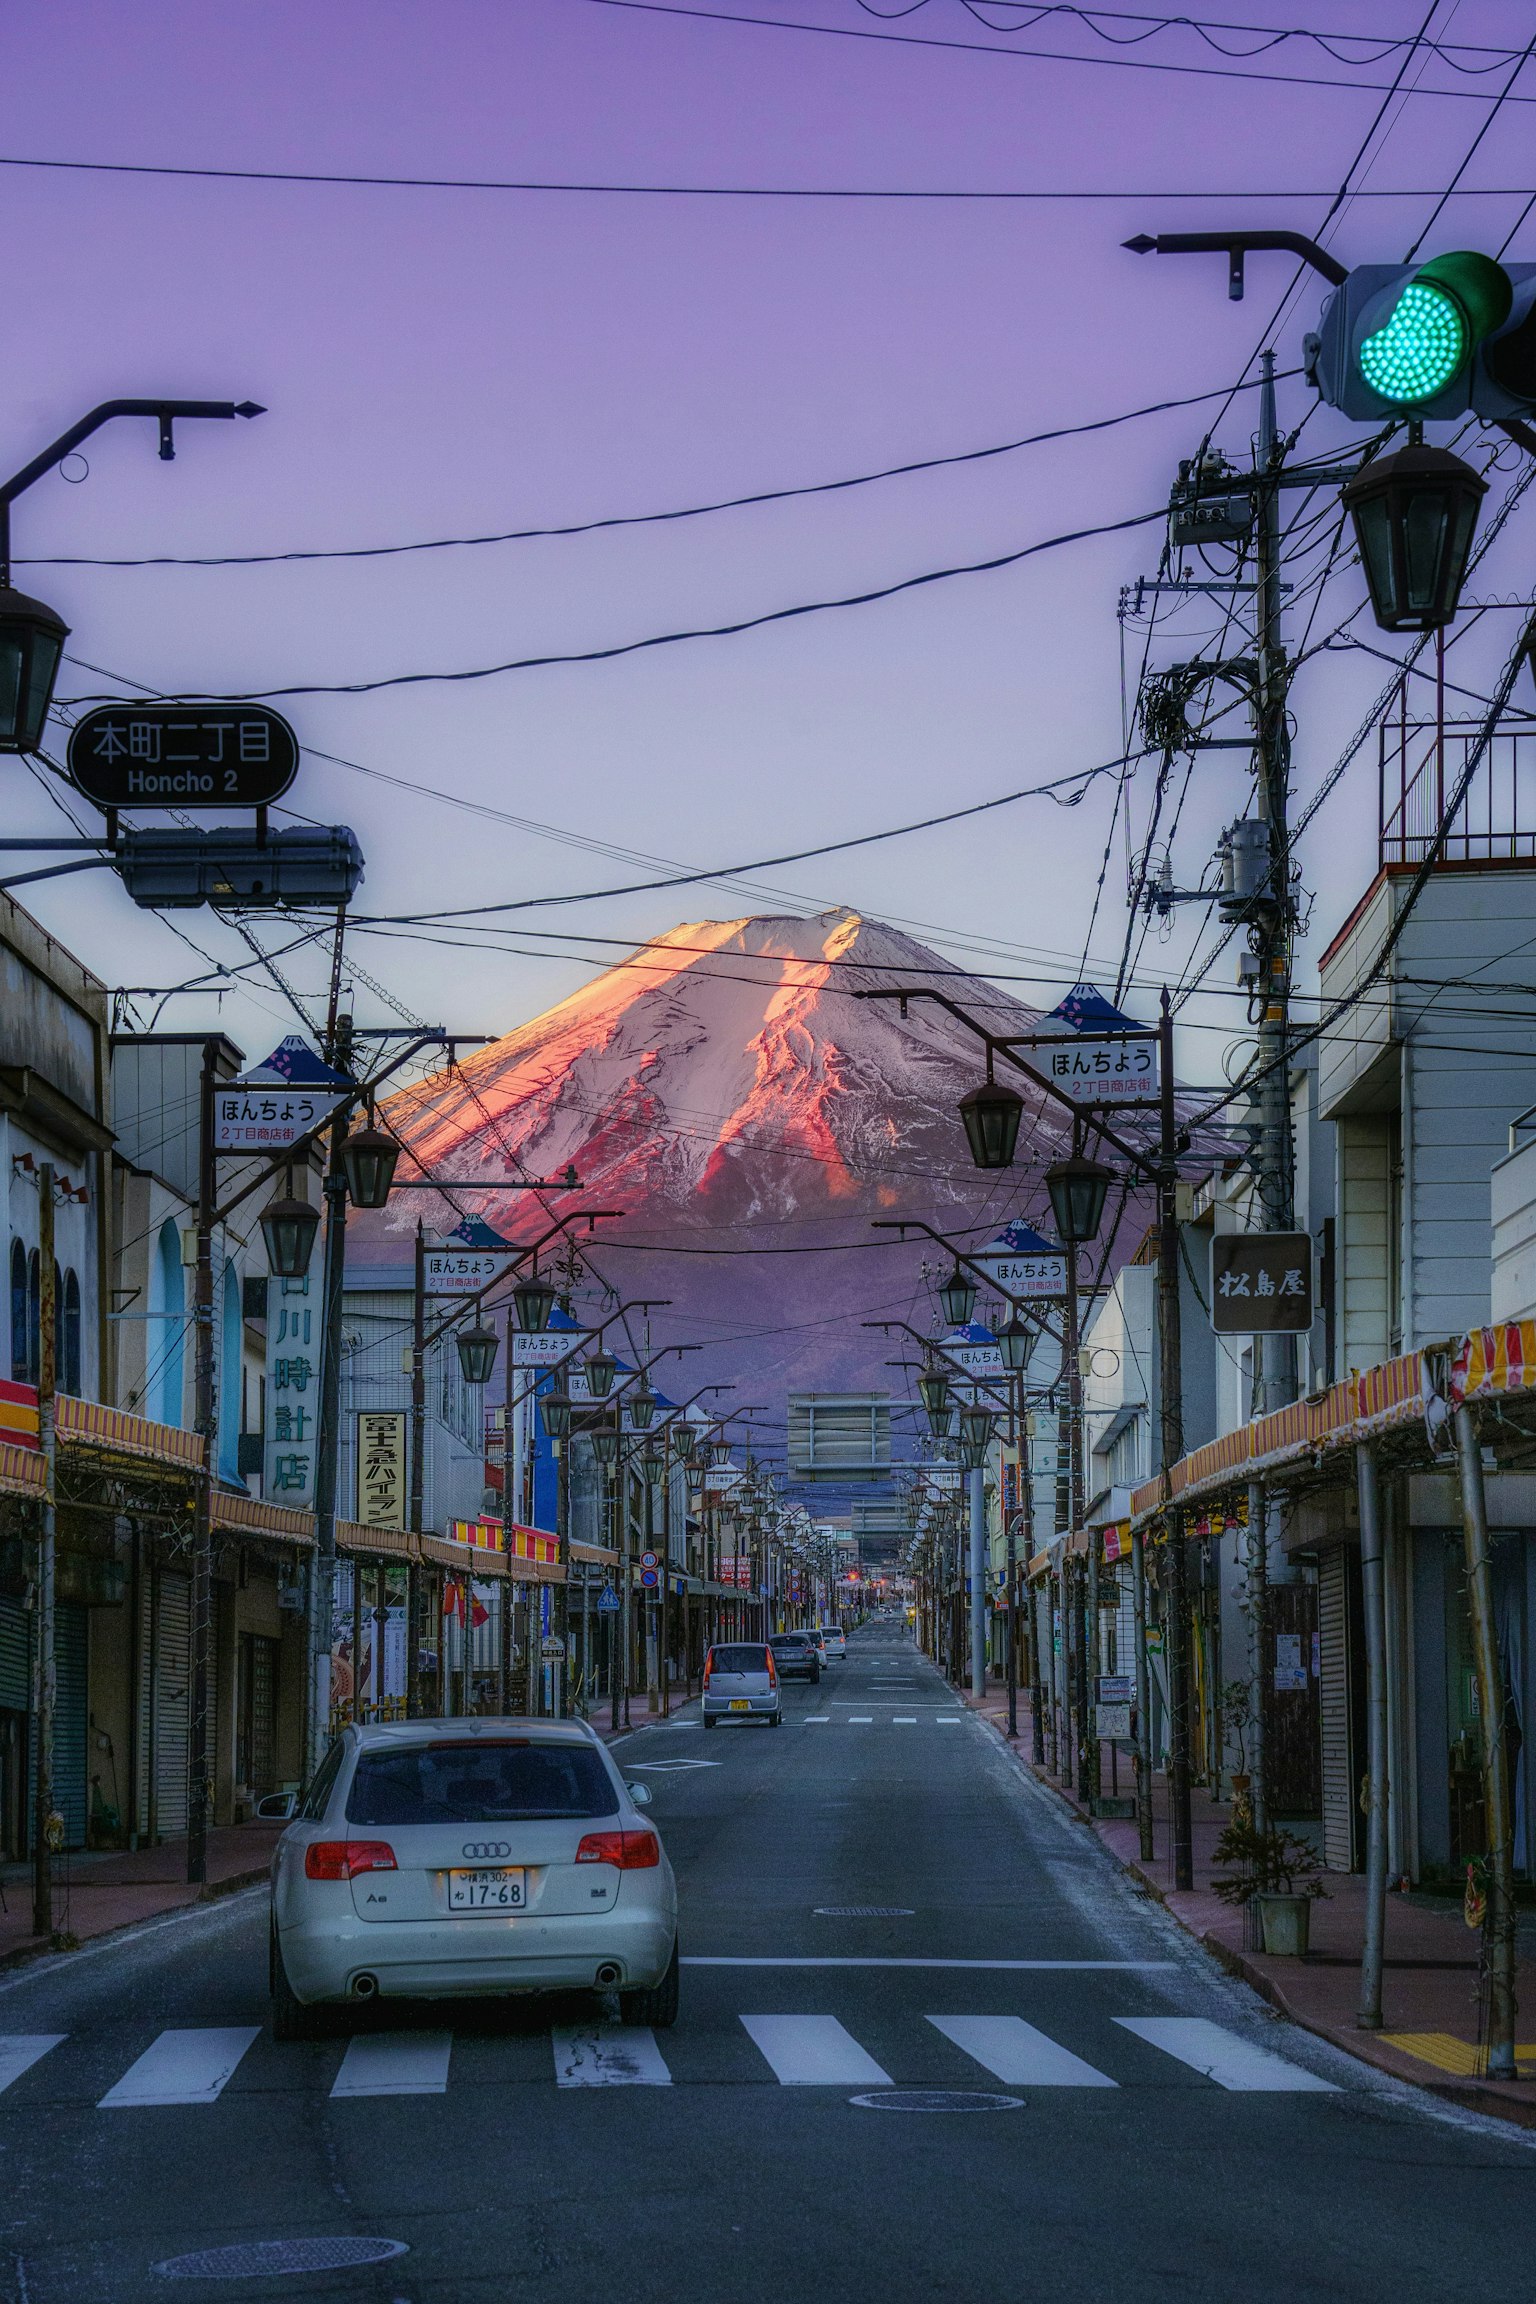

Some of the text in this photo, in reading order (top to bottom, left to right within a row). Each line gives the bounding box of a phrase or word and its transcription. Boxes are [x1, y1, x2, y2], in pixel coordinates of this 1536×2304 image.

[93, 721, 270, 764] 本町二丁目
[128, 769, 239, 793] Honcho 2
[1052, 1048, 1151, 1076] ほんちょう
[1072, 1077, 1151, 1096] 2丁目商店街
[222, 1099, 314, 1121] ほんちょう
[221, 1127, 295, 1141] 2丁目商店街
[430, 1258, 495, 1274] ほんちょう
[997, 1262, 1061, 1279] ほんちょう
[429, 1277, 481, 1287] 2丁目商店街
[1011, 1279, 1062, 1292] 2丁目商店街
[1217, 1267, 1307, 1299] 松島屋
[517, 1337, 569, 1350] ほんちょう
[961, 1352, 1001, 1364] ほんちょ
[972, 1364, 1004, 1373] 2丁目商店
[365, 1416, 399, 1530] 富士急ハイラン
[490, 1871, 508, 1883] 302
[470, 1884, 521, 1905] 17-68
